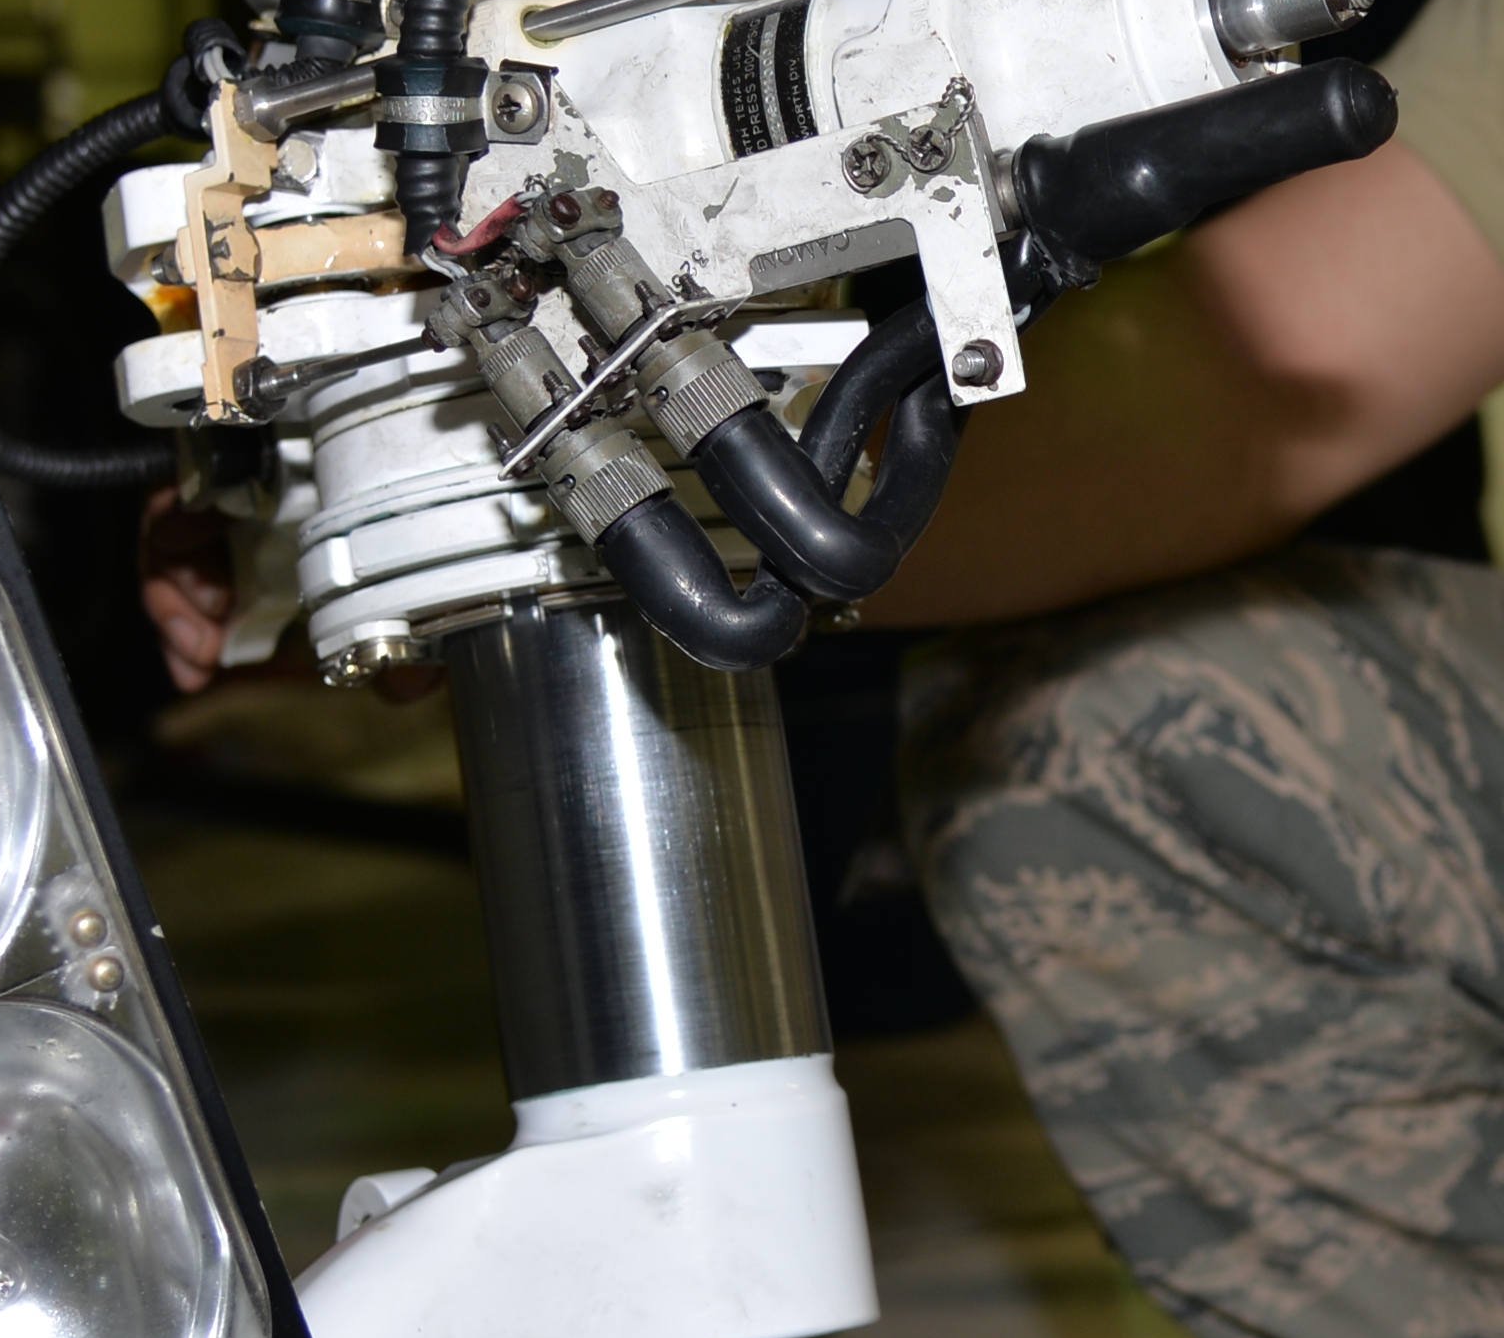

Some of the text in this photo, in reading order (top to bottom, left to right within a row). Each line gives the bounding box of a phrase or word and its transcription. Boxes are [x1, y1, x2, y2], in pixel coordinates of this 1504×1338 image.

[733, 45, 742, 71] USA
[789, 58, 800, 82] DIV
[732, 77, 745, 121] TEXAS
[745, 83, 764, 136] PRESS
